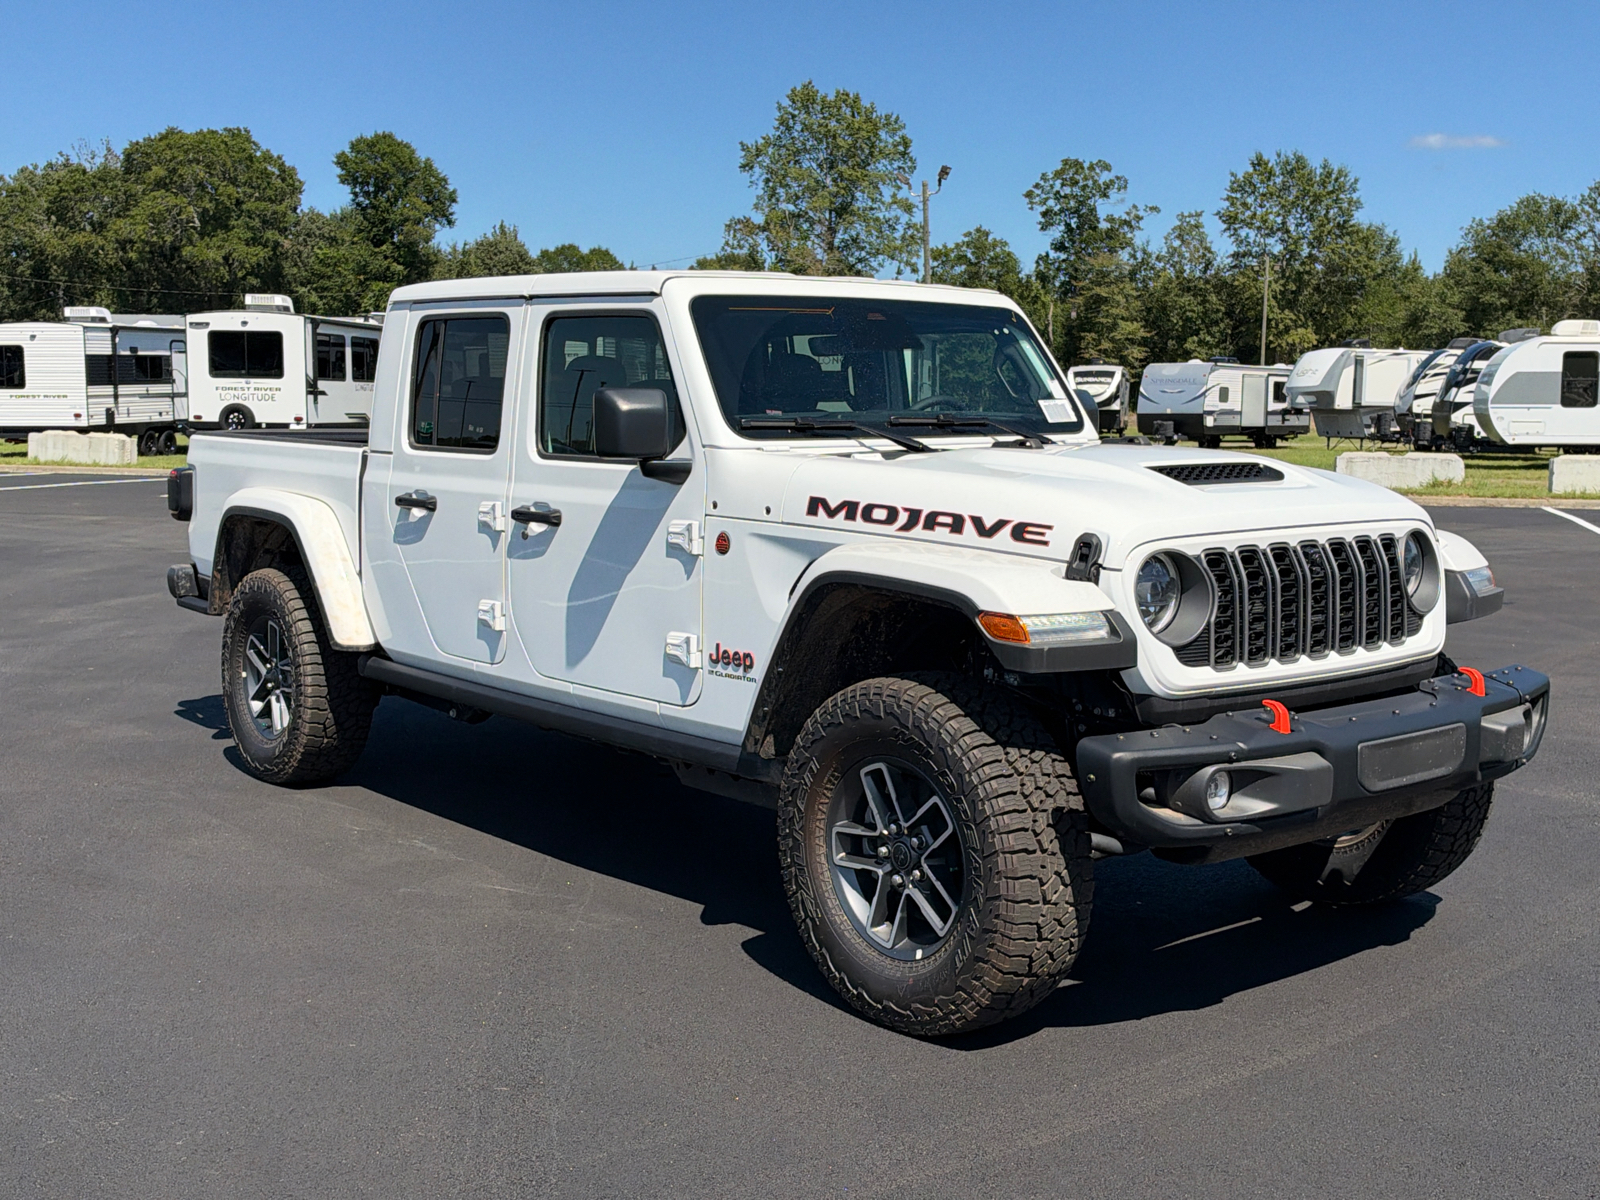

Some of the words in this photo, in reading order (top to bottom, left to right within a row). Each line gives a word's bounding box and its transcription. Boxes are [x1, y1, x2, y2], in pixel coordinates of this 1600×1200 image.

[219, 392, 277, 402] LONGITUDE
[805, 495, 1055, 547] MOJAVE
[708, 642, 755, 674] Jeep
[714, 670, 757, 683] GLADIATOR
